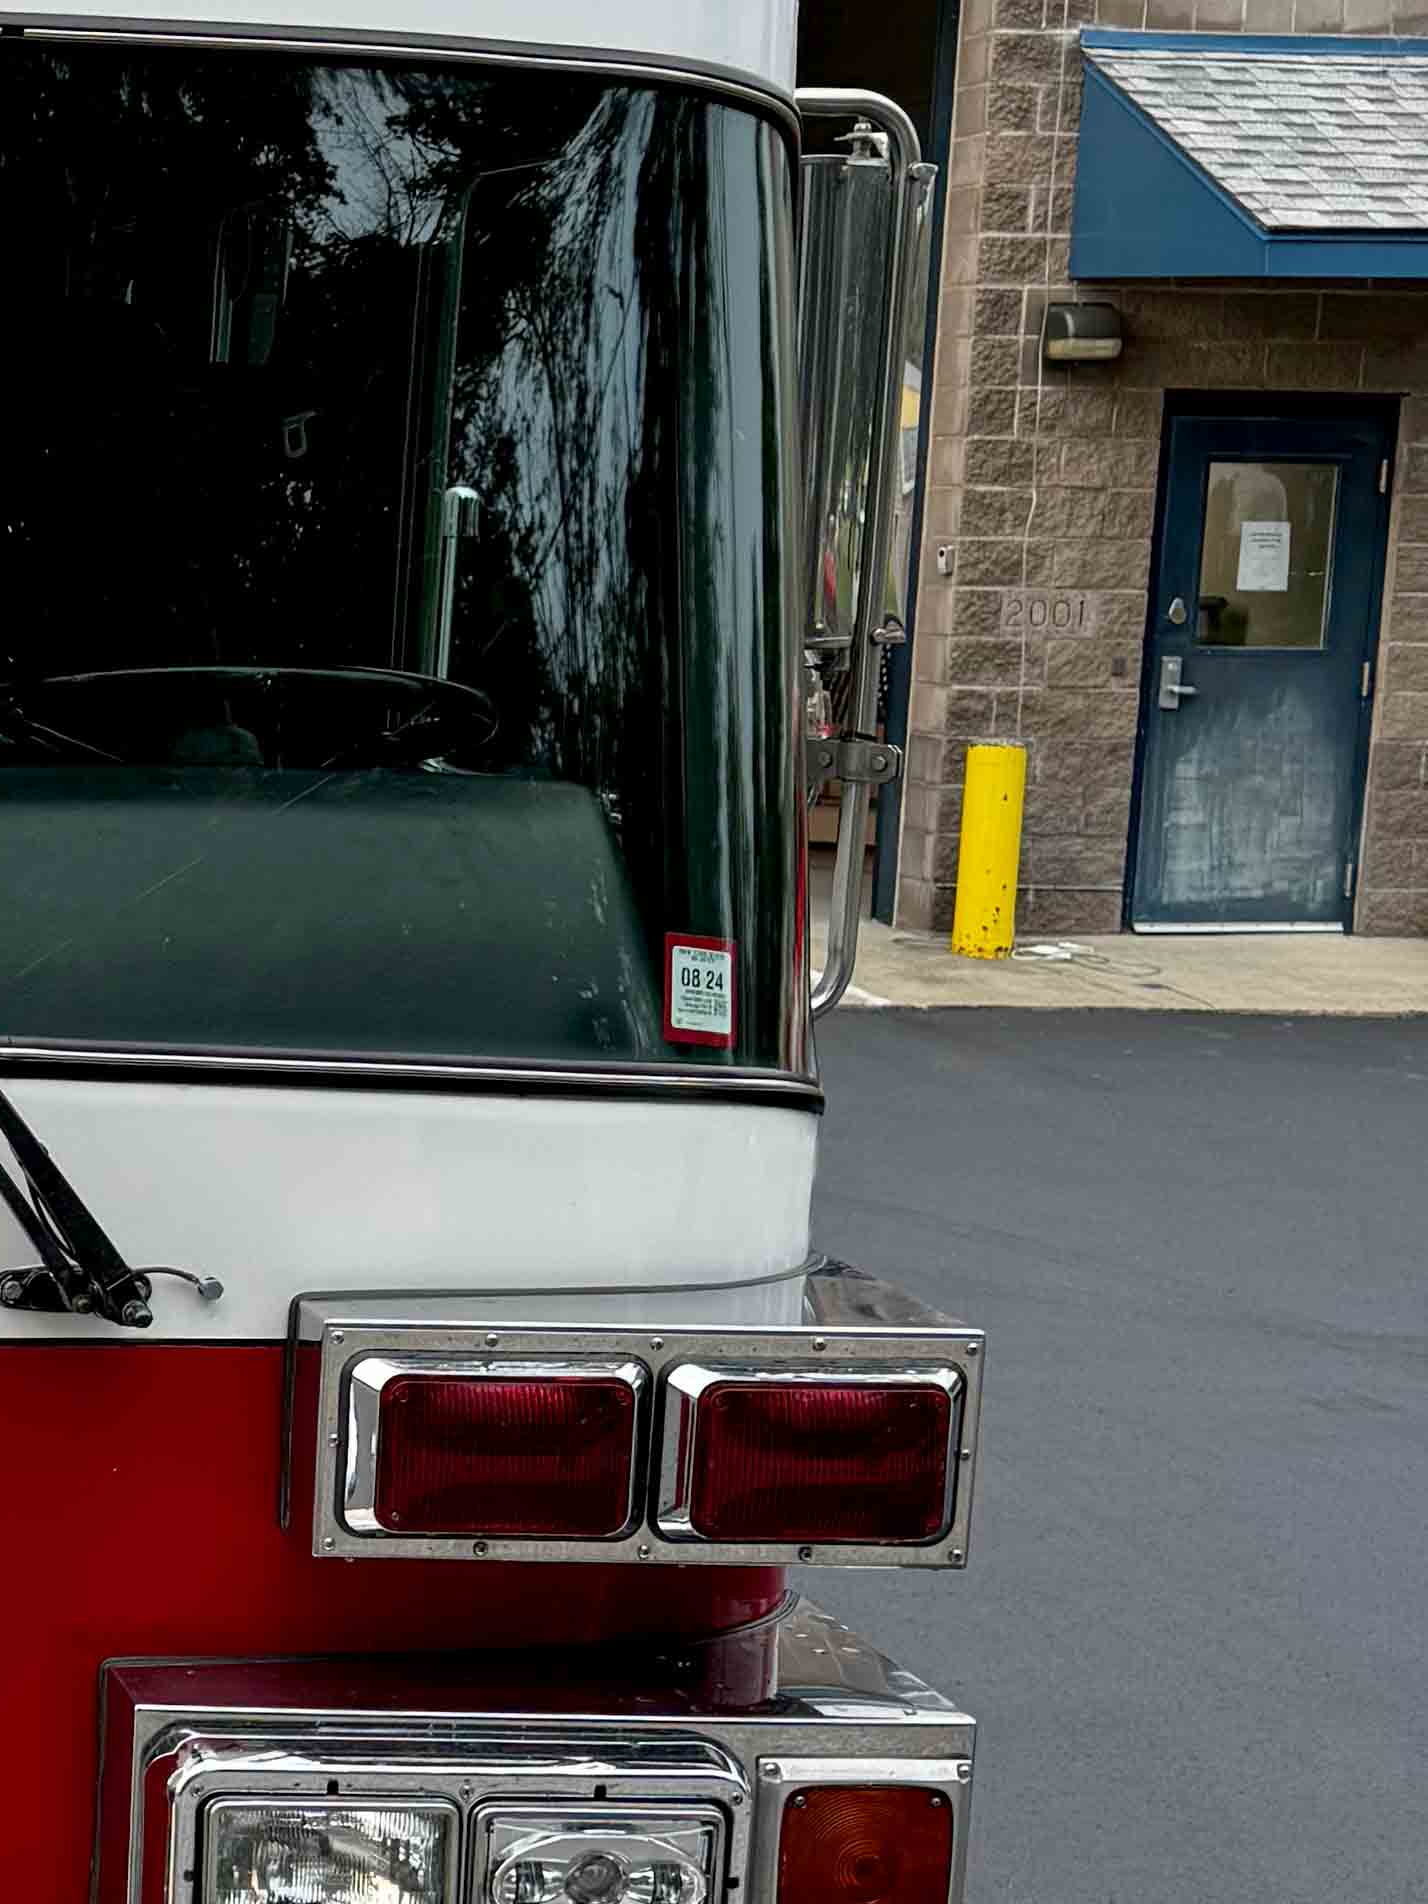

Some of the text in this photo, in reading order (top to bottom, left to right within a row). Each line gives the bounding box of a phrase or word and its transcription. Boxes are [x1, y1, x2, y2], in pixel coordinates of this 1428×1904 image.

[1005, 599, 1085, 628] 2001
[681, 967, 723, 991] 08 24
